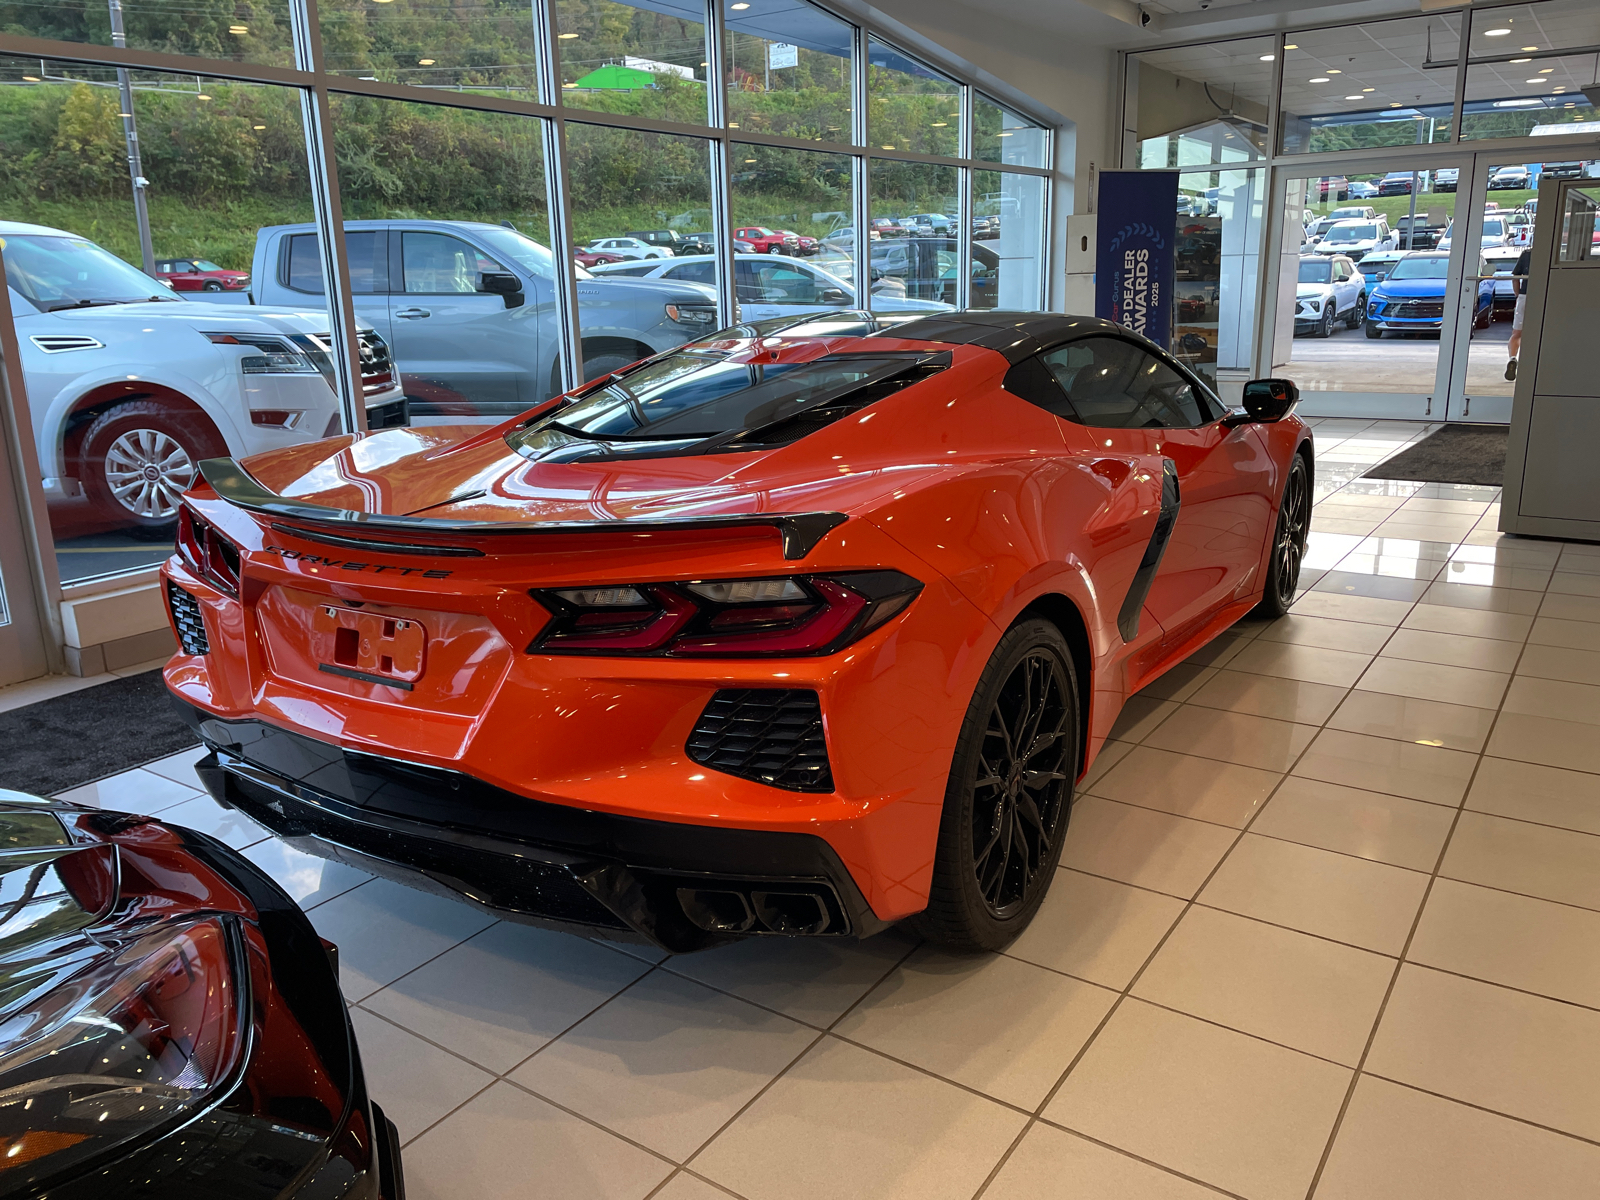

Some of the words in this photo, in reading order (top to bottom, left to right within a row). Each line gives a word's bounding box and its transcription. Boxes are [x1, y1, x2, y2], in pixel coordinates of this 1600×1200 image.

[1123, 250, 1135, 310] DEALER
[1134, 249, 1149, 335] AWARDS
[1151, 282, 1159, 307] 2025
[1123, 312, 1133, 330] OP
[264, 545, 453, 579] CORVETTE
